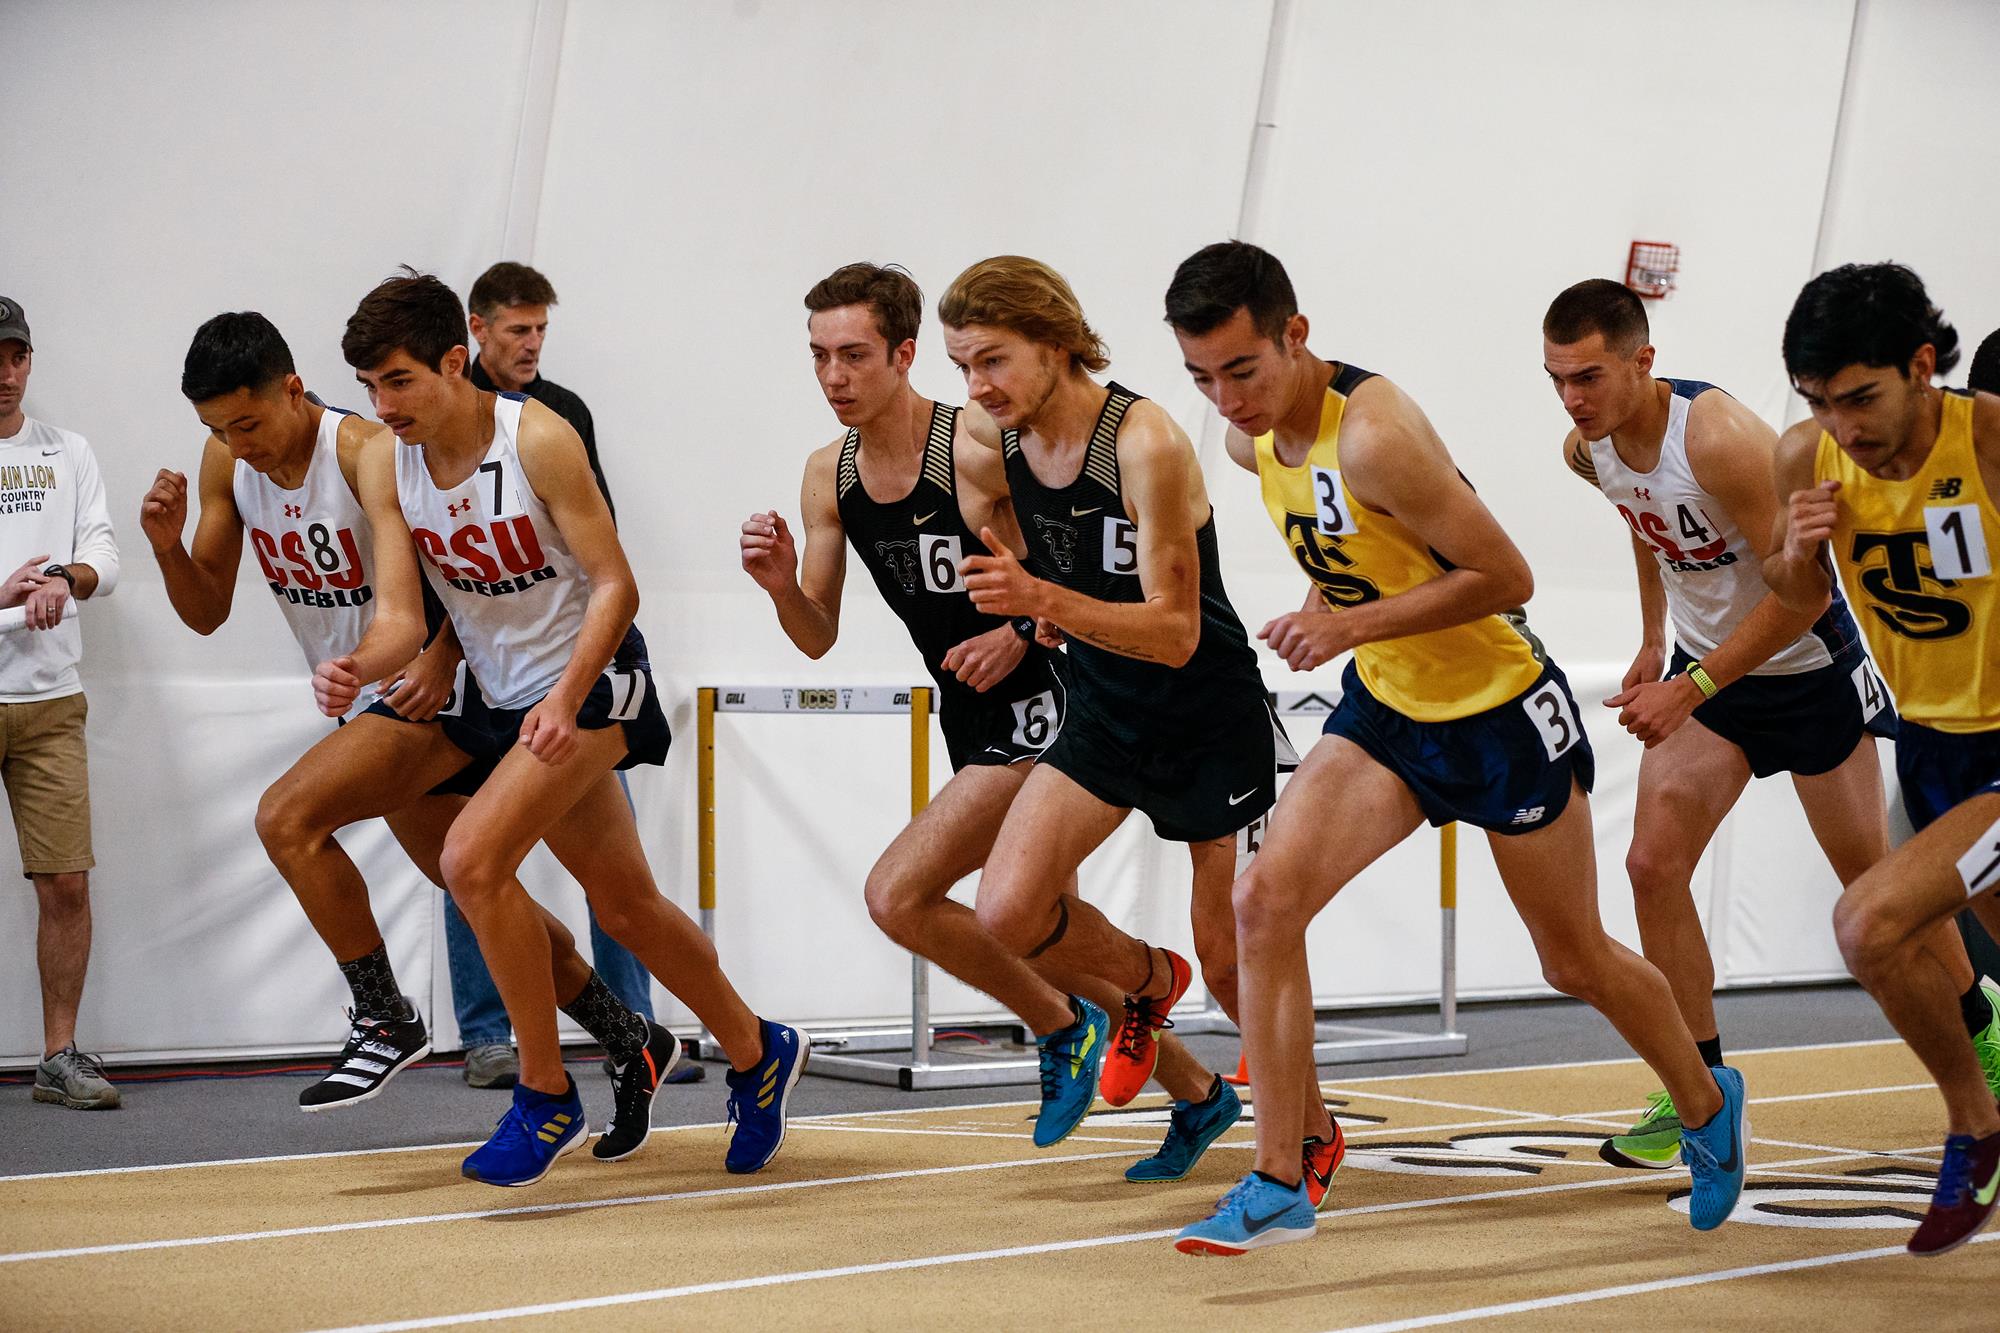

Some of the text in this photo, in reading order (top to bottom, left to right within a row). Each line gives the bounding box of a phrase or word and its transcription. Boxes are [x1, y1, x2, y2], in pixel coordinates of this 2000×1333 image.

[1, 490, 46, 503] COUNTRY
[24, 465, 56, 489] LION
[480, 461, 503, 516] 7
[6, 505, 14, 514] &
[15, 502, 42, 513] FIELD
[1317, 472, 1343, 532] 3
[1676, 503, 1711, 544] 4
[308, 523, 340, 572] 8
[411, 514, 546, 584] CSU
[929, 538, 956, 590] 6
[1114, 522, 1138, 573] 5
[1940, 511, 1973, 574] 1
[446, 565, 558, 597] UEBLO
[613, 669, 637, 717] 7
[725, 692, 745, 704] GILL
[798, 689, 837, 709] UCCS
[893, 692, 912, 706] GIL
[1862, 664, 1880, 711] 4
[1023, 696, 1050, 746] 6
[1534, 691, 1570, 754] 3
